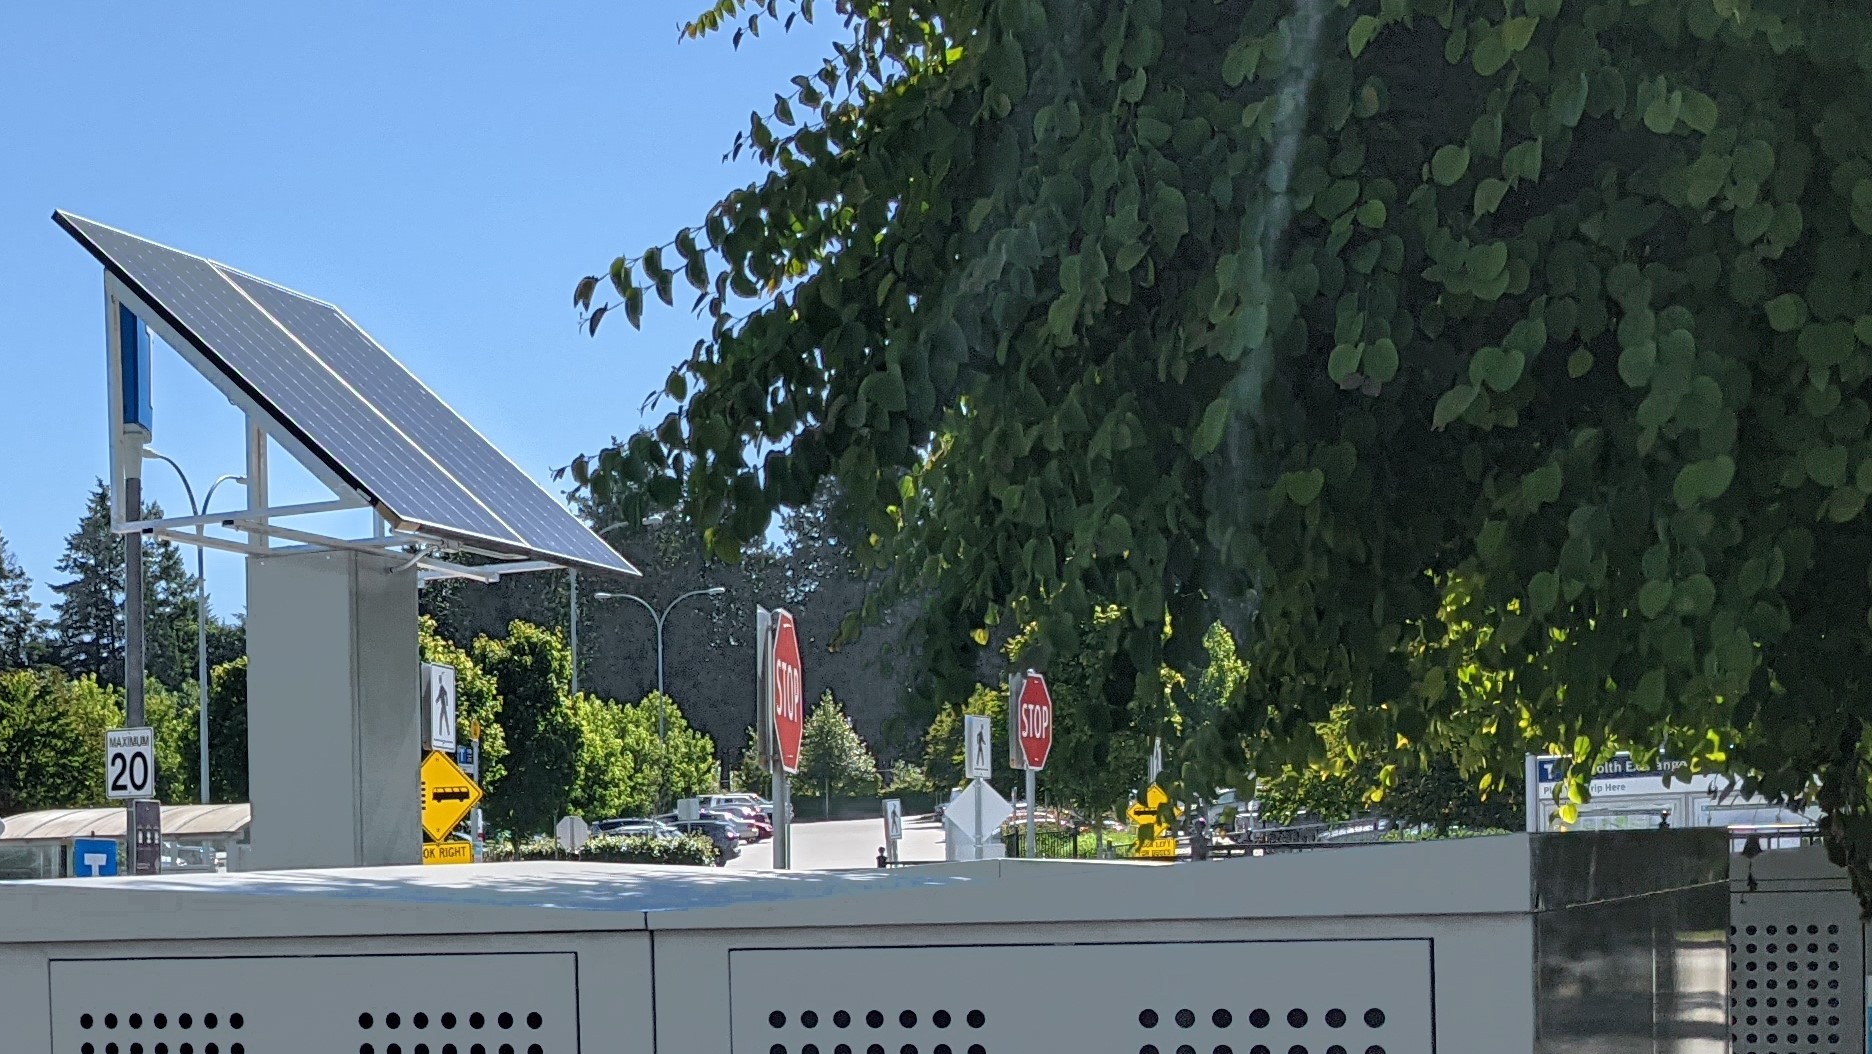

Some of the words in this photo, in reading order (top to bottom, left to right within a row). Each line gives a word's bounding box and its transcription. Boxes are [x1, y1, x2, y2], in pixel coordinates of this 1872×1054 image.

[776, 658, 799, 722] STOP
[1022, 703, 1048, 738] STOP
[109, 735, 149, 748] MAXIMUM
[111, 751, 148, 791] 20
[1591, 784, 1603, 793] rip
[1605, 784, 1626, 792] Here
[423, 848, 436, 859] OK
[439, 846, 466, 859] RIGHT
[84, 853, 107, 876] T
